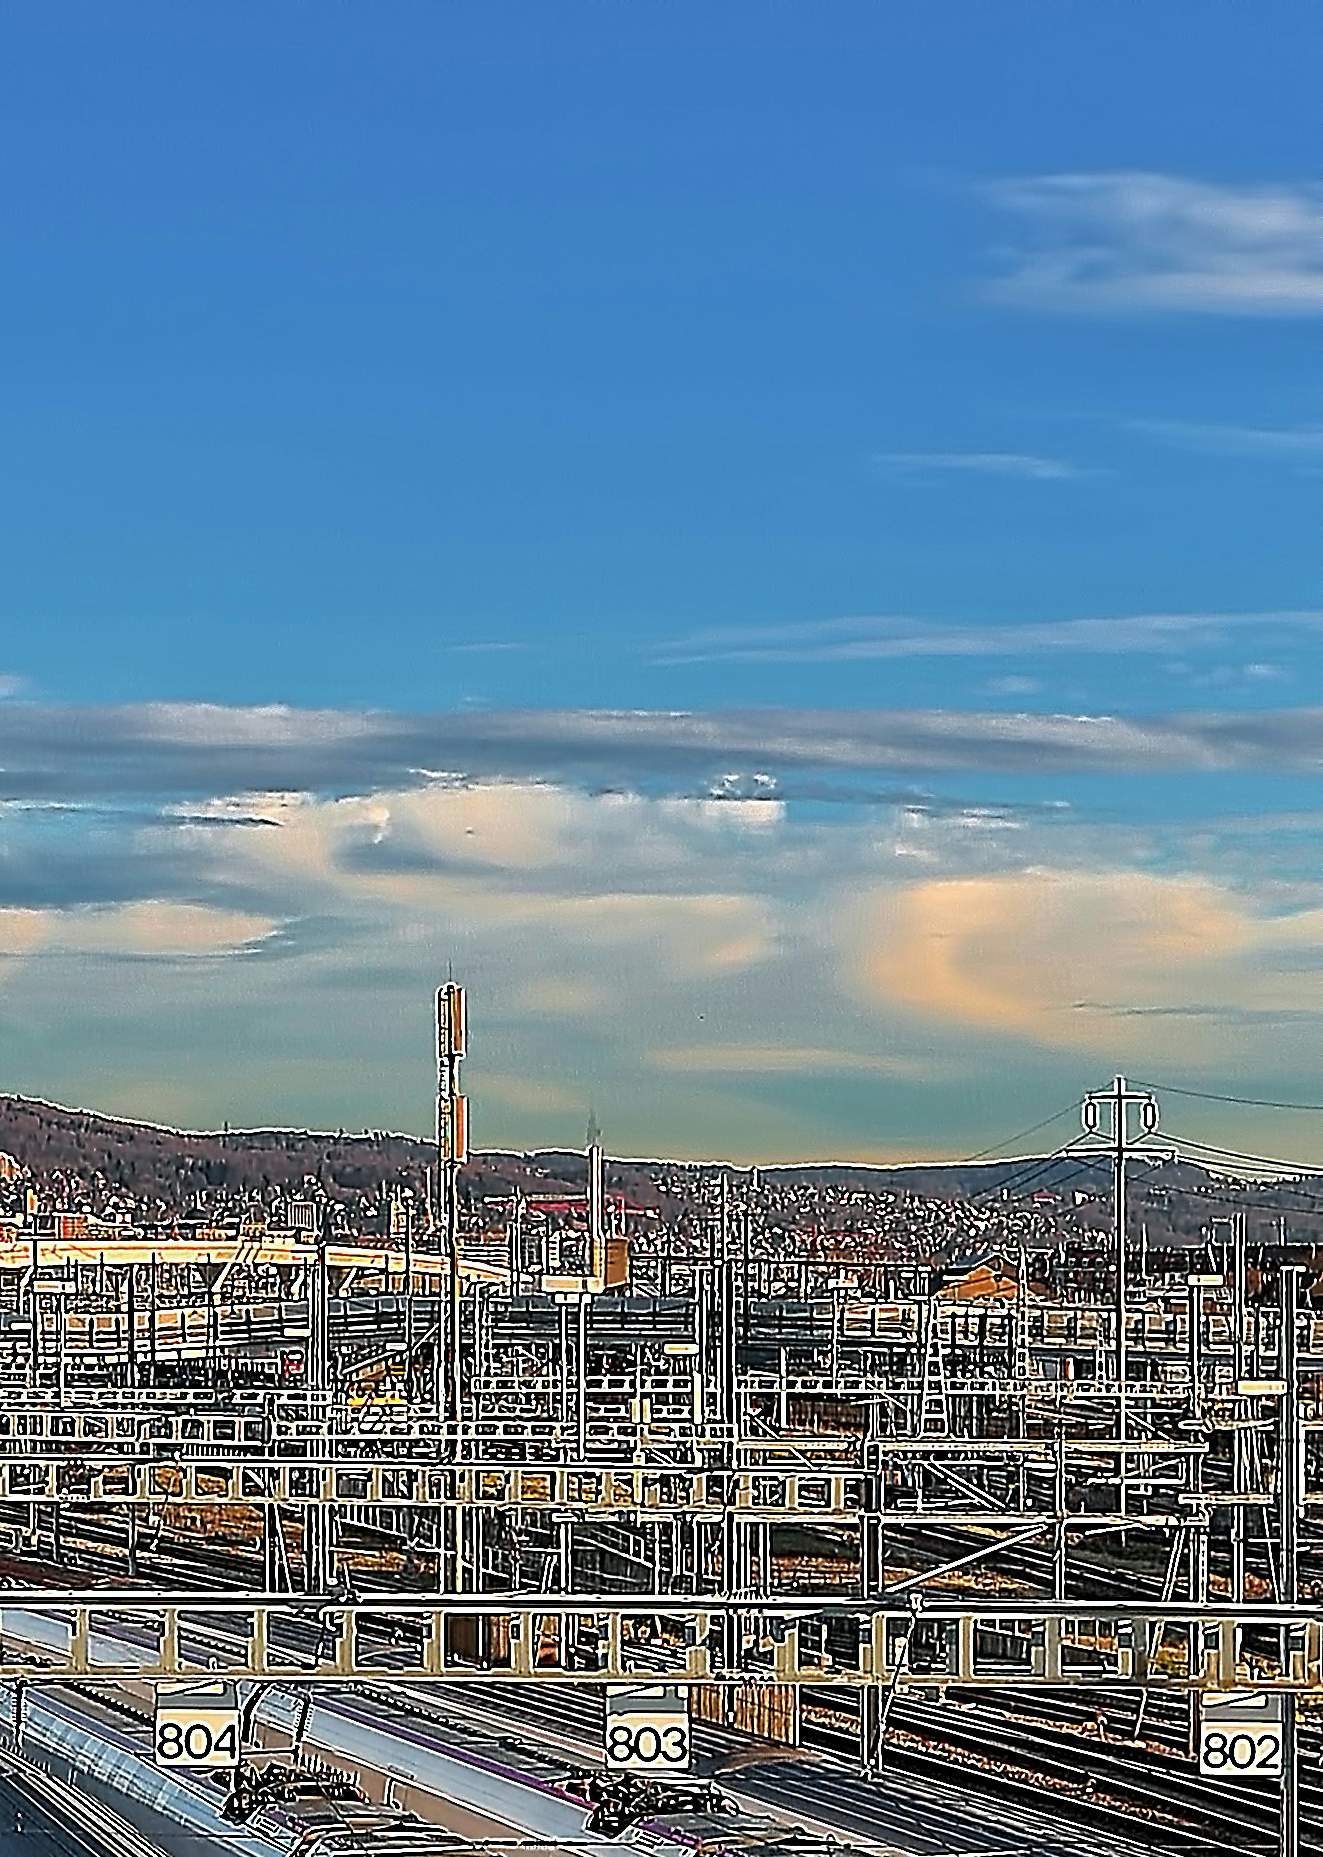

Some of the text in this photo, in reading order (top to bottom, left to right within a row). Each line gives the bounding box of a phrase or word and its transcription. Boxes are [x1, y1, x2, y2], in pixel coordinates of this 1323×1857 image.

[157, 1722, 237, 1760] 804
[607, 1725, 688, 1762] 803
[1202, 1732, 1280, 1769] 802
